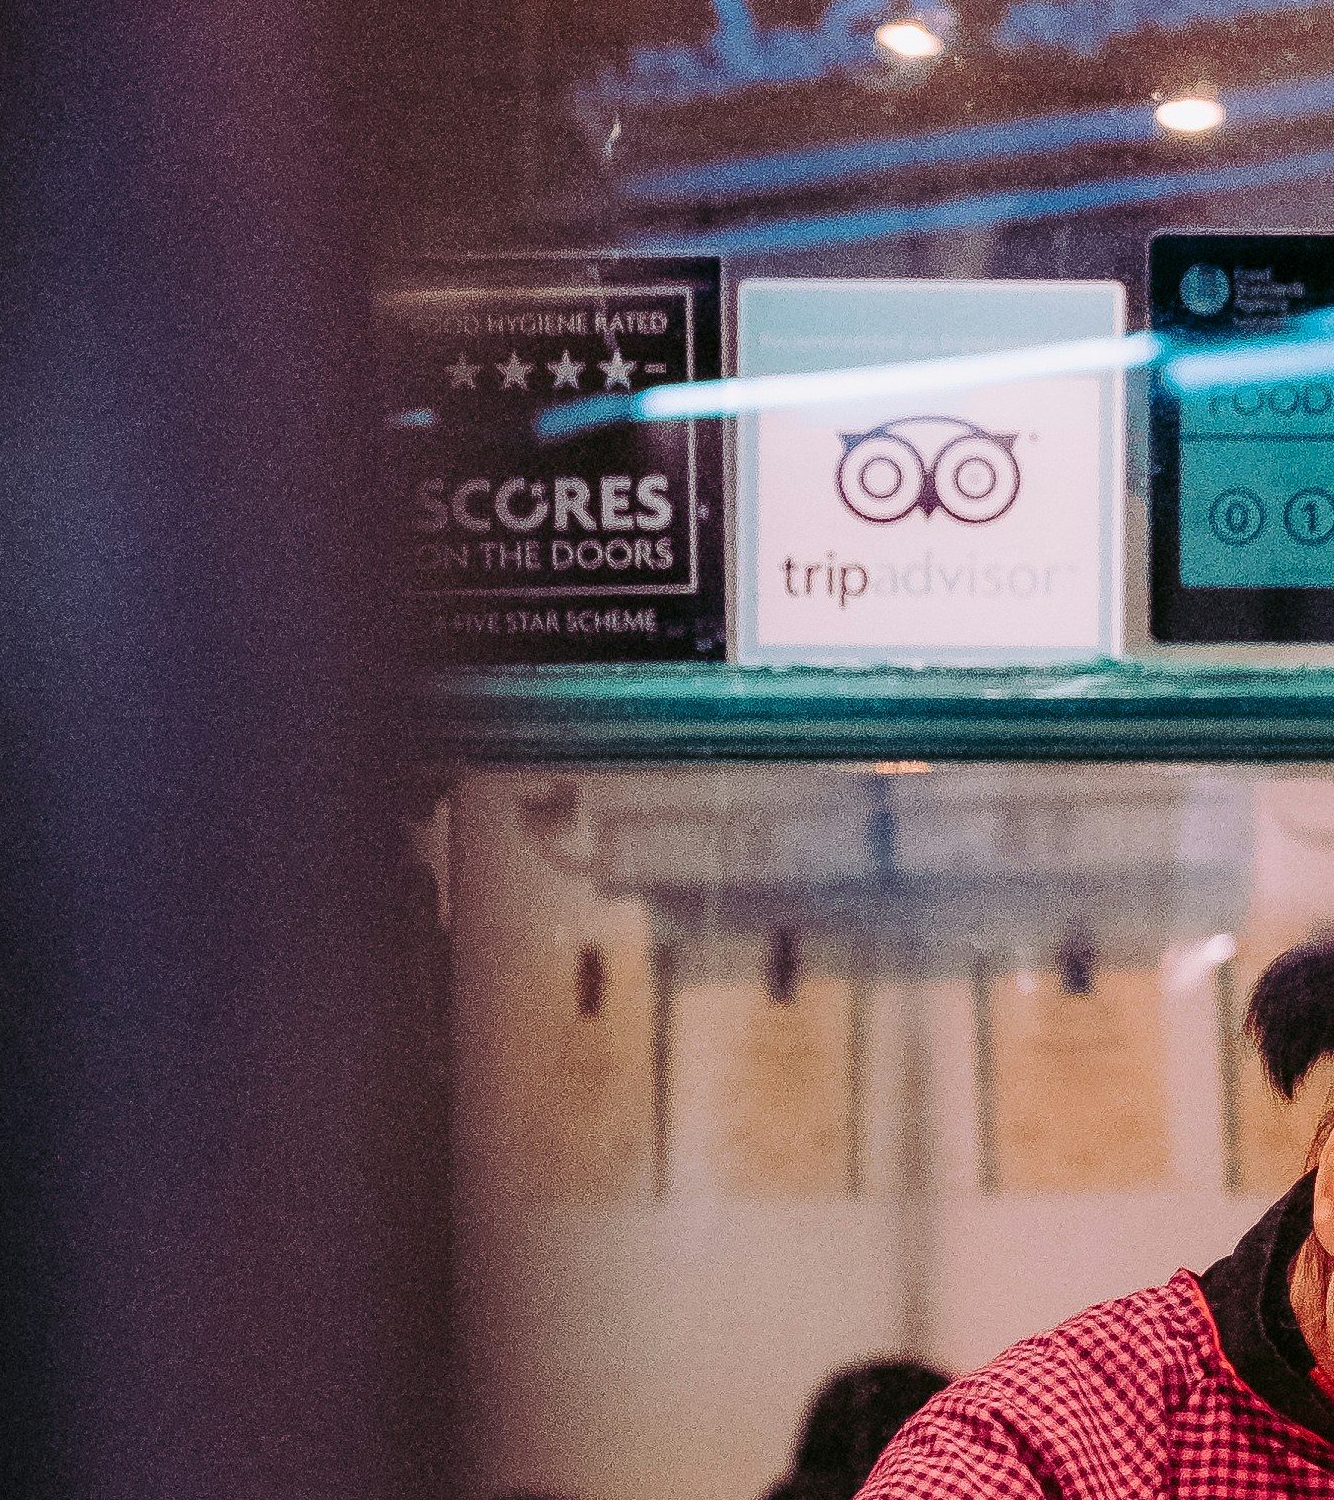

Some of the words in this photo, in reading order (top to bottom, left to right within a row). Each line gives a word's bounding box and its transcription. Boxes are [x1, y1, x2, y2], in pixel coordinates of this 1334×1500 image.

[487, 314, 584, 336] HYGIENE
[594, 311, 669, 335] RATED
[417, 474, 674, 533] SCORES
[1224, 499, 1249, 532] 0
[1302, 500, 1321, 533] 1
[480, 541, 541, 570] THE
[551, 538, 674, 570] DOORS
[782, 551, 1056, 610] tripadvisor
[505, 610, 561, 634] STAR
[566, 607, 658, 634] SCHEME
